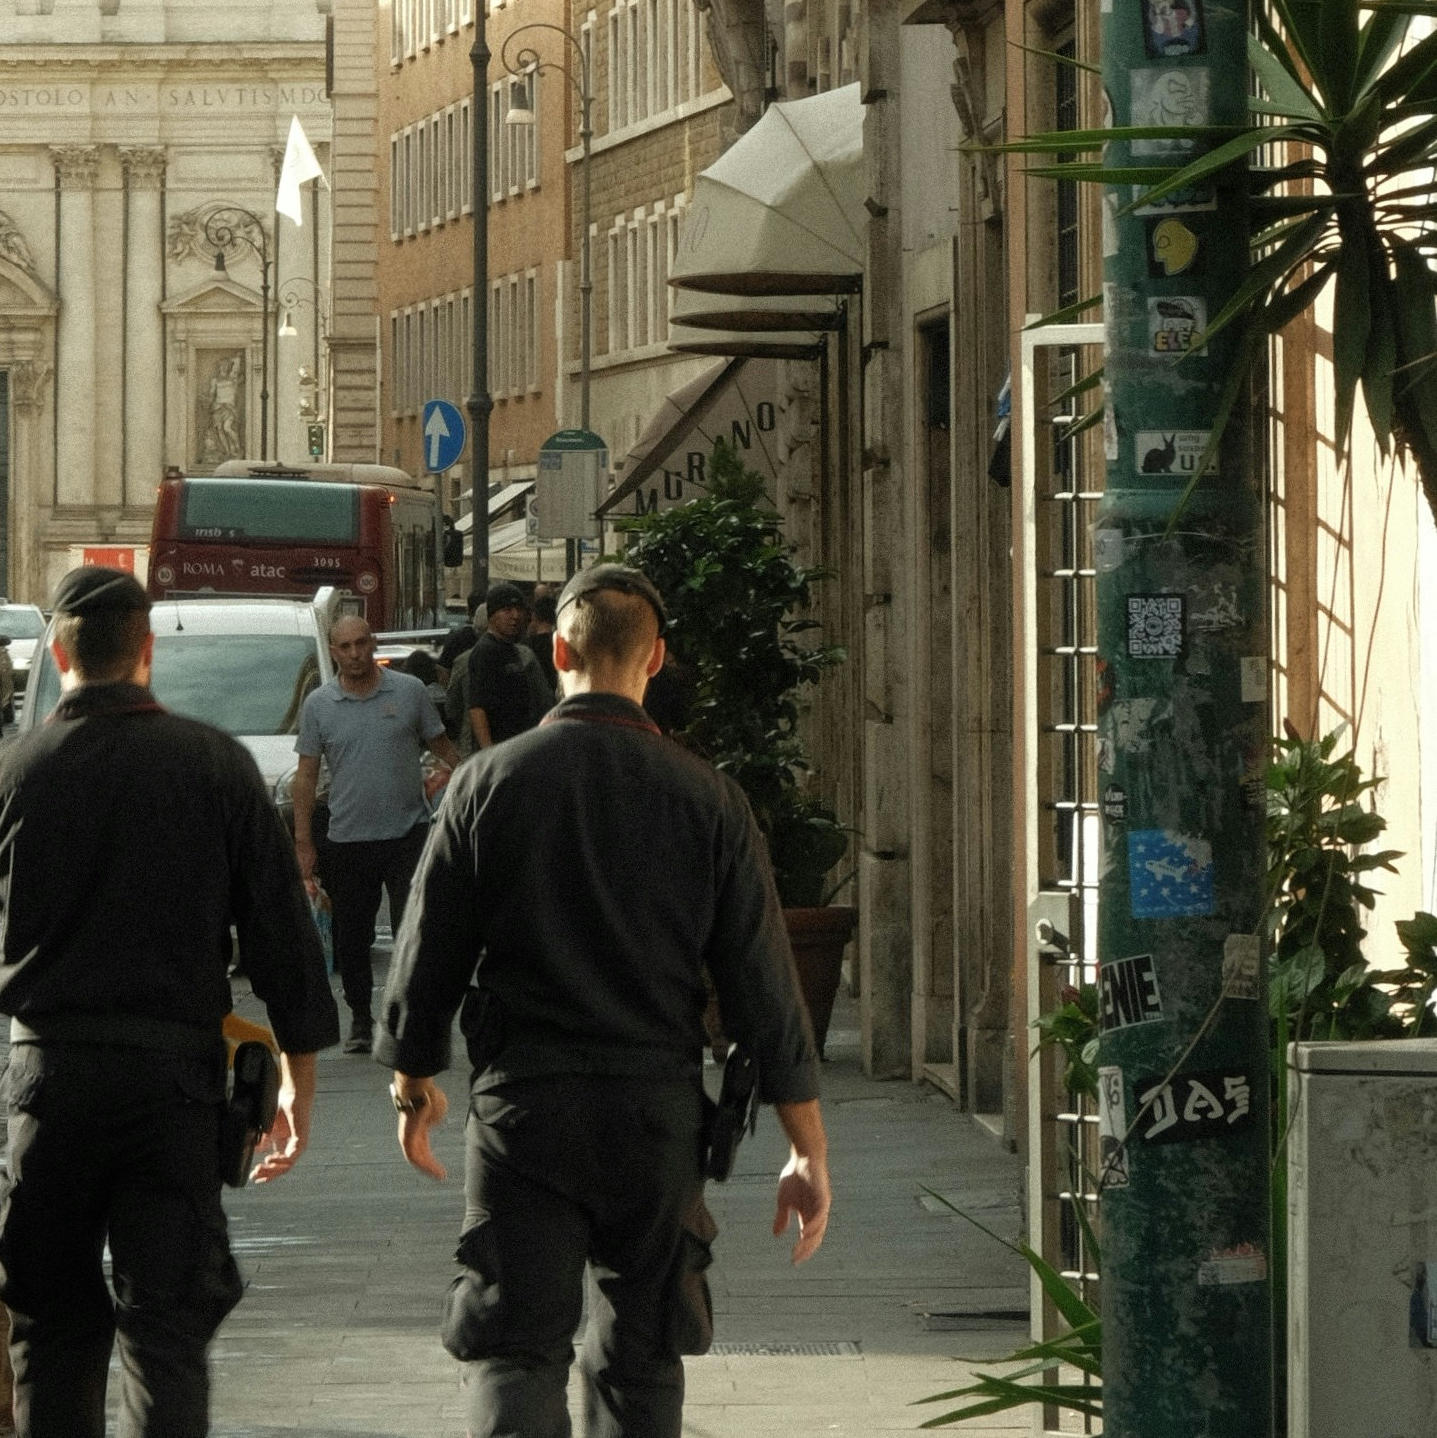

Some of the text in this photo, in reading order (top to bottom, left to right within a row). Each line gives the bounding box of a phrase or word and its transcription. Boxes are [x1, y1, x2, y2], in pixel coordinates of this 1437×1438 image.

[313, 557, 341, 568] 3095
[183, 562, 286, 579] ROMA atac
